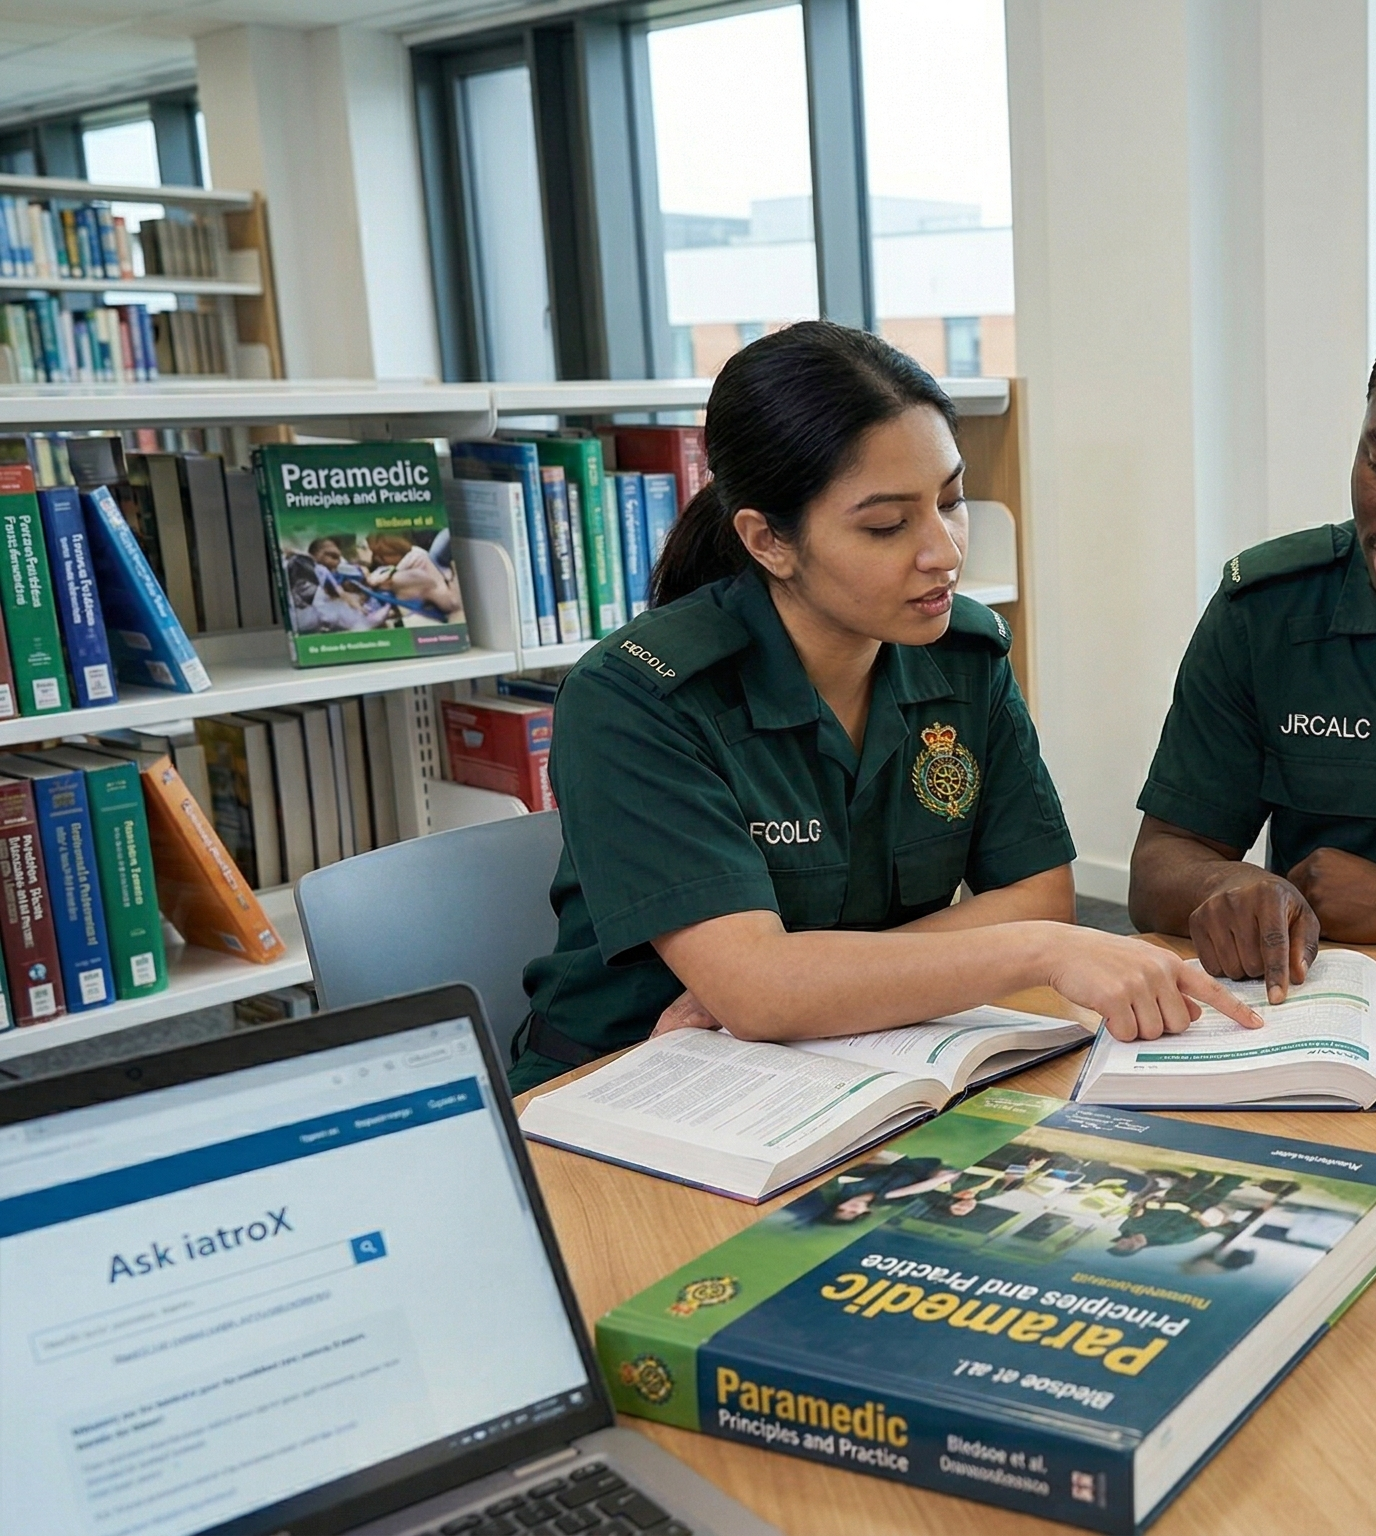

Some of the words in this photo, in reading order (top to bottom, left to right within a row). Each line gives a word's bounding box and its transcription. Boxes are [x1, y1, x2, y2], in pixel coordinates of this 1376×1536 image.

[281, 460, 430, 490] Paramedic
[286, 492, 350, 508] Principles
[353, 490, 377, 504] and
[380, 487, 431, 502] Practice
[1280, 713, 1371, 739] JRCALC
[108, 1242, 175, 1284] Ask
[183, 1206, 295, 1260] iatroX
[861, 1253, 978, 1293] Practice
[981, 1277, 1039, 1301] and
[820, 1272, 1169, 1377] Paramedic
[1040, 1290, 1190, 1338] Principles
[715, 1367, 909, 1448] Paramedic
[1020, 1374, 1115, 1410] Bledsoe
[718, 1408, 800, 1446] Principles
[803, 1431, 835, 1455] and
[839, 1440, 909, 1473] Practice
